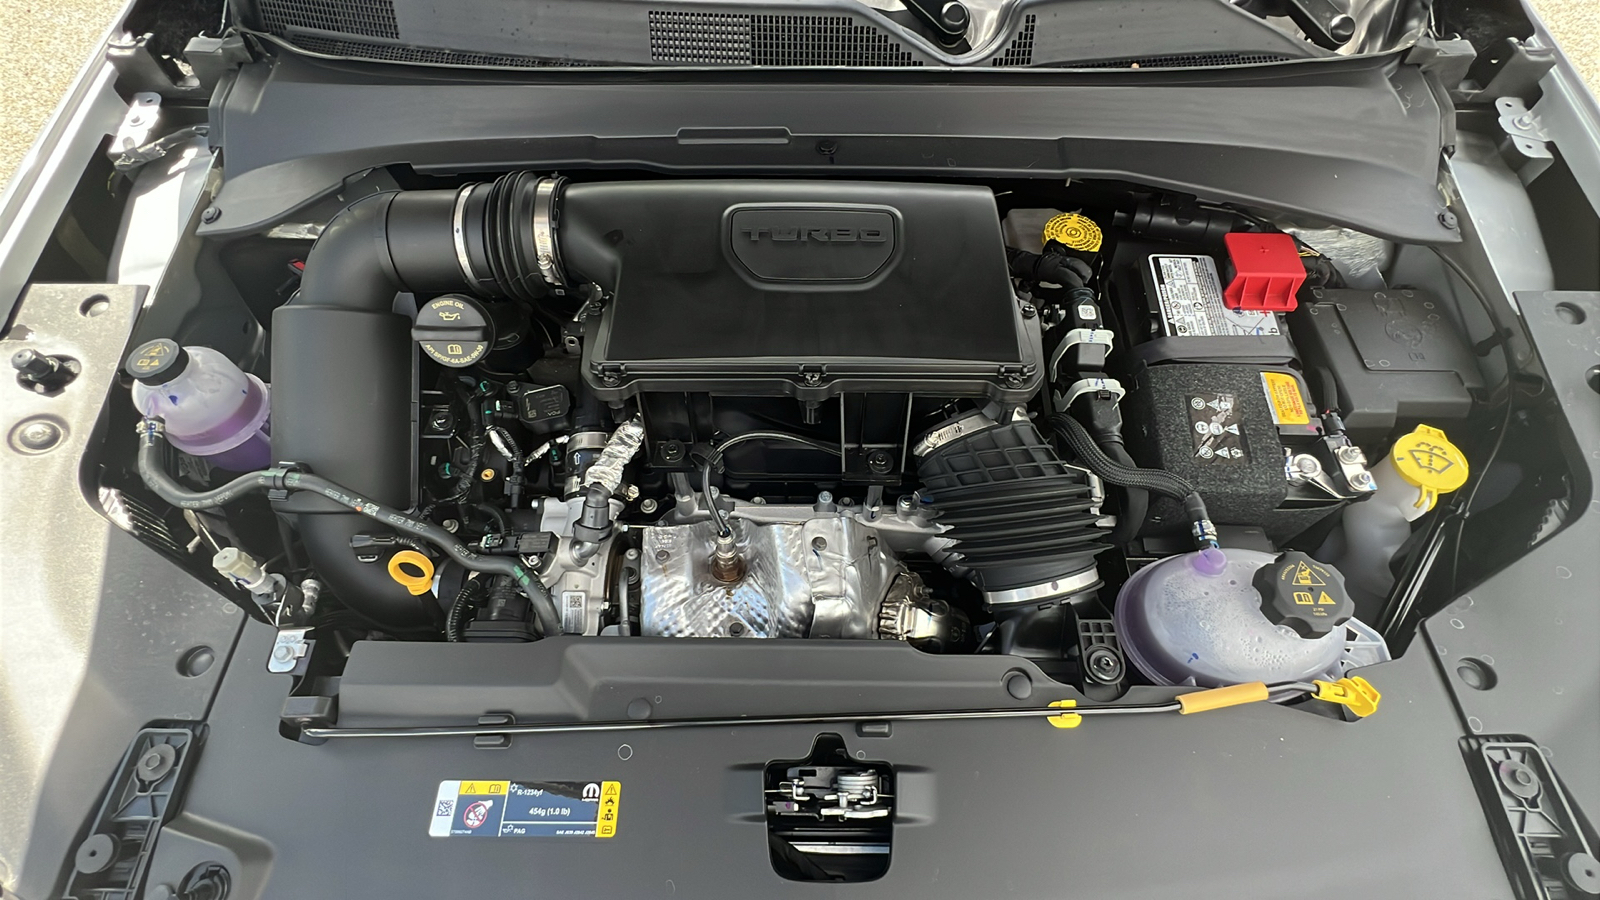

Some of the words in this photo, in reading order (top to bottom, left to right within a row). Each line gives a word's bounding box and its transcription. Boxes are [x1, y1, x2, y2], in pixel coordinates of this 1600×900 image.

[741, 227, 887, 243] TURBO
[431, 300, 454, 310] ENGINE
[454, 301, 465, 310] OIL
[516, 788, 544, 798] R-1234yf
[528, 807, 546, 817] 454g
[546, 807, 560, 816] (1.0
[560, 807, 571, 817] lb)
